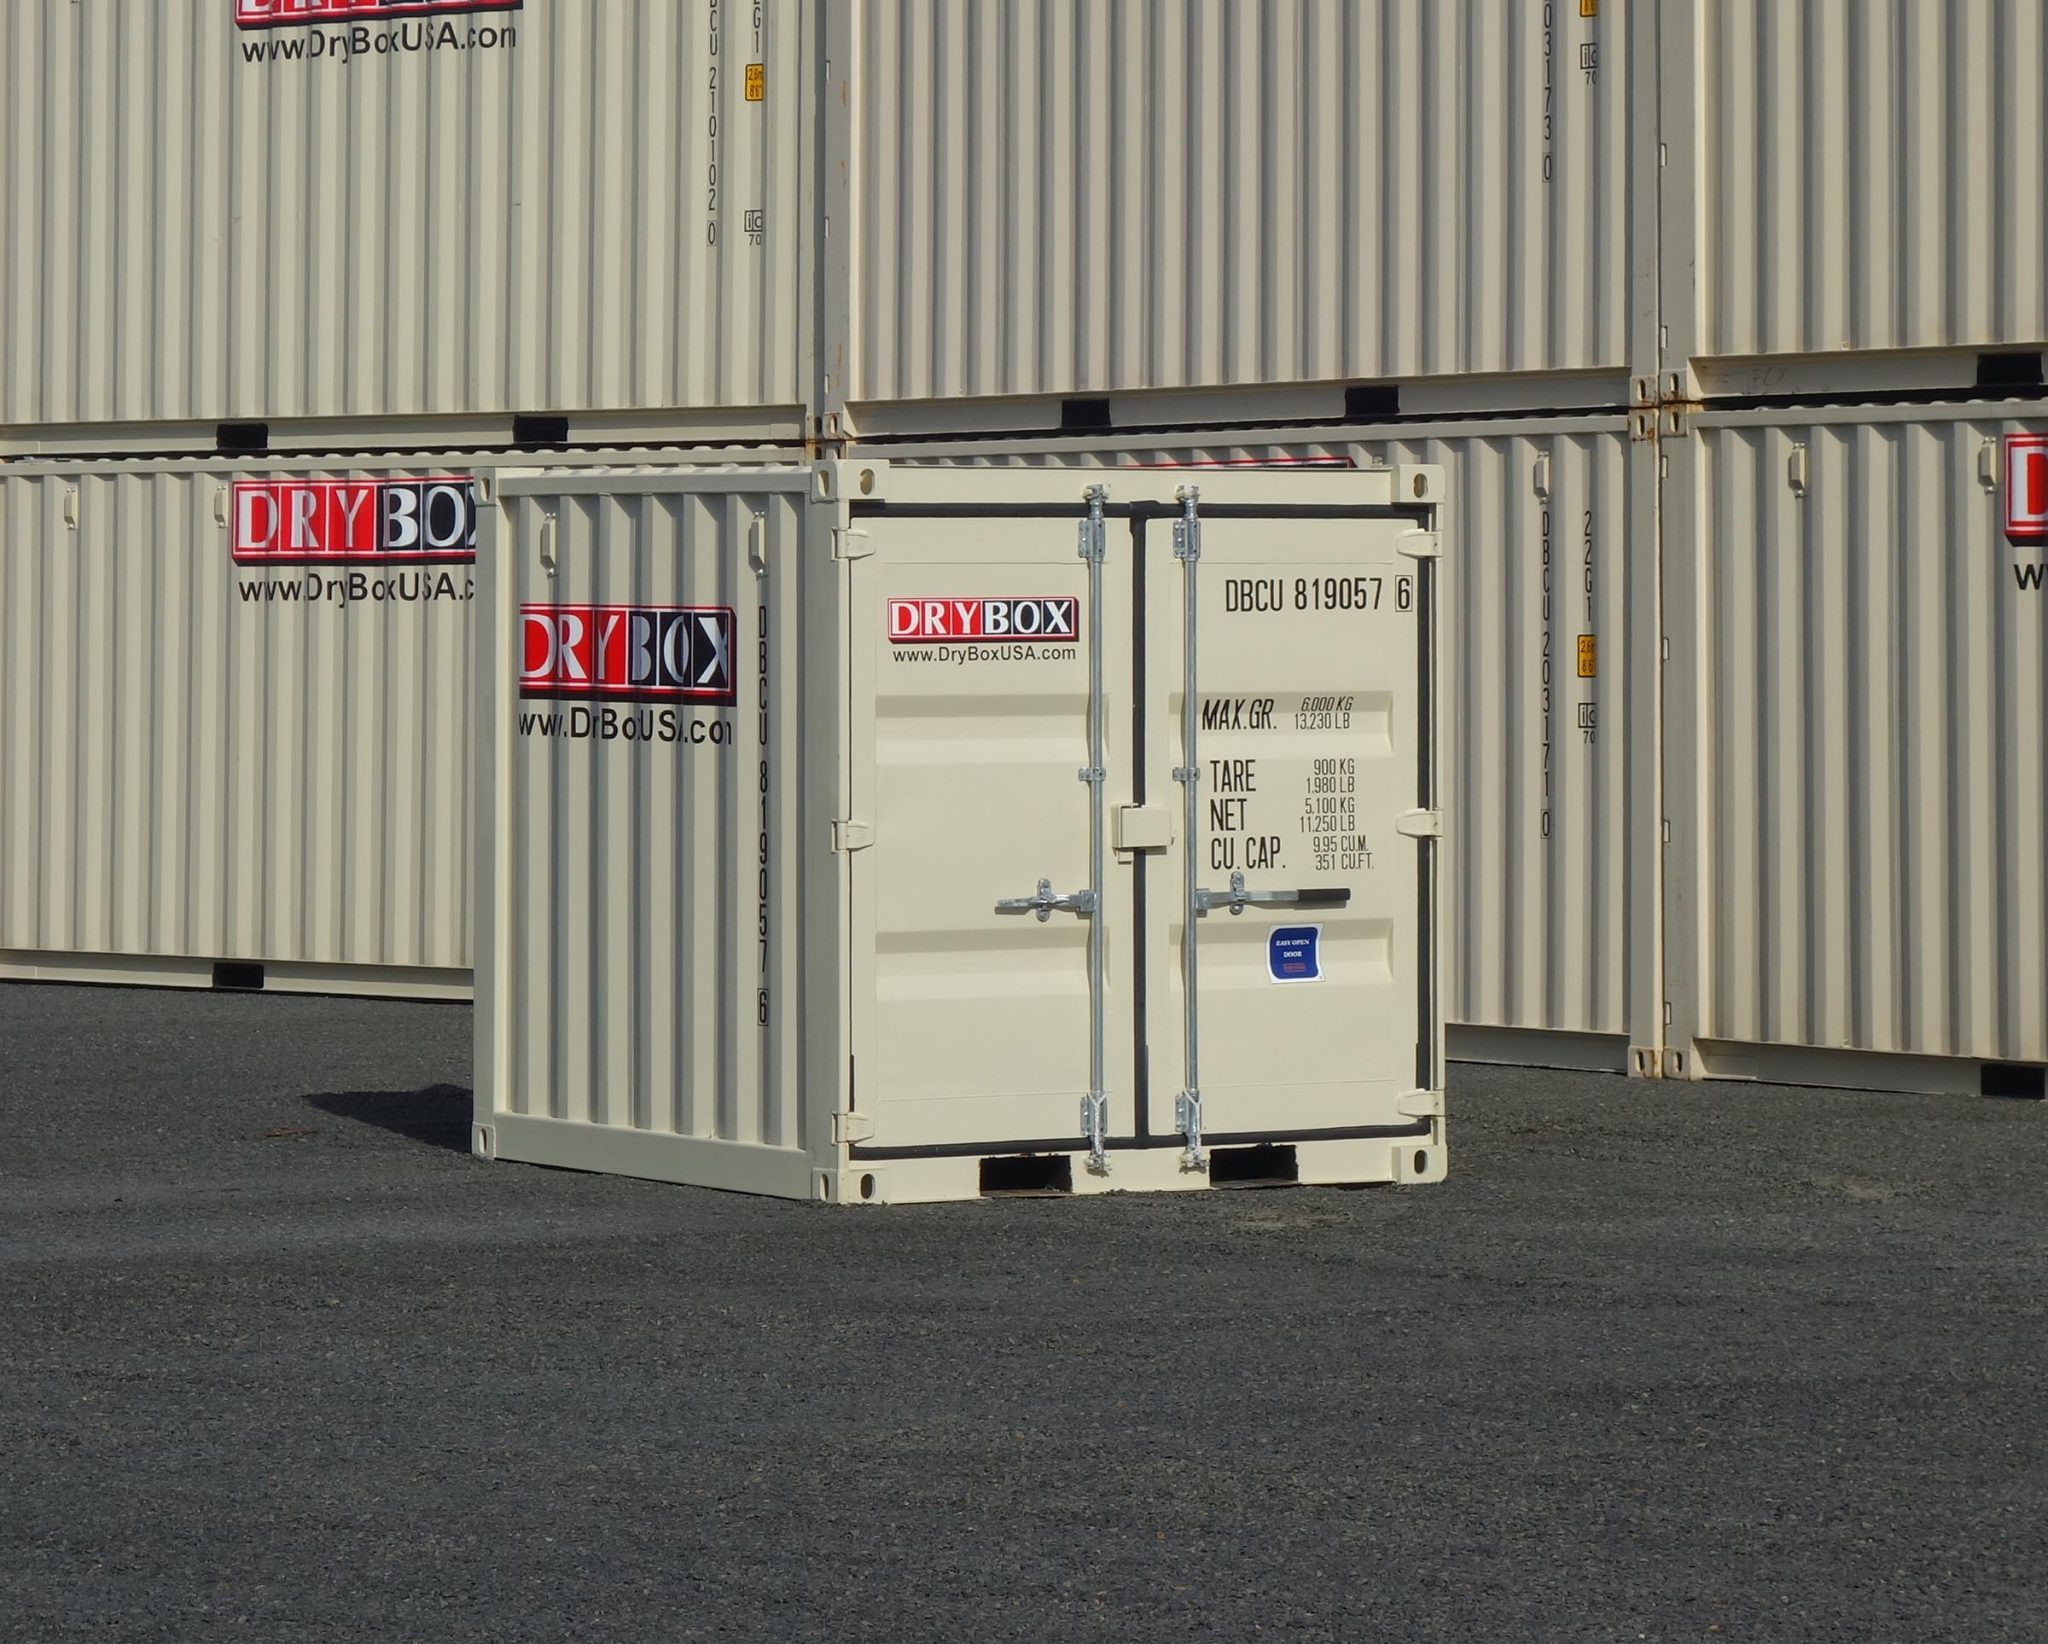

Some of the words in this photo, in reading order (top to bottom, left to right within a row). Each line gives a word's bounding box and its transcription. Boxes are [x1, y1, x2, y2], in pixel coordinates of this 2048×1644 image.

[241, 21, 517, 64] www.DryBoxUSA.com
[753, 0, 761, 54] G1
[708, 66, 717, 210] 210102
[1543, 154, 1551, 181] 0
[708, 222, 716, 245] 0
[748, 233, 762, 246] 70
[237, 485, 475, 549] DRYBO
[1542, 511, 1550, 621] DBCU
[1584, 510, 1592, 622] 22G1
[1225, 578, 1283, 612] DBCU
[1294, 577, 1382, 611] 819057
[1397, 577, 1411, 610] 6
[891, 600, 1071, 636] DRYBOX
[519, 613, 728, 684] DRYBOX
[893, 645, 1076, 665] www.DryBoxUSA.com
[759, 605, 767, 745] DBCU
[1202, 698, 1277, 731] MAX.GR.
[1336, 696, 1353, 711] KG
[1542, 631, 1550, 797] 203171
[1335, 713, 1351, 729] LB
[1583, 730, 1596, 744] 70
[1210, 759, 1257, 793] TARE
[1313, 758, 1337, 775] 900
[1339, 758, 1355, 775] KG
[1339, 776, 1355, 793] LB
[1210, 798, 1248, 832] NET
[1340, 797, 1355, 814] KG
[1340, 815, 1355, 832] LB
[1542, 811, 1550, 837] 0
[759, 760, 768, 973] 819057
[1211, 837, 1240, 871] CU.
[1245, 836, 1286, 869] CAP.
[1315, 854, 1336, 871] 351
[759, 990, 767, 1024] 6
